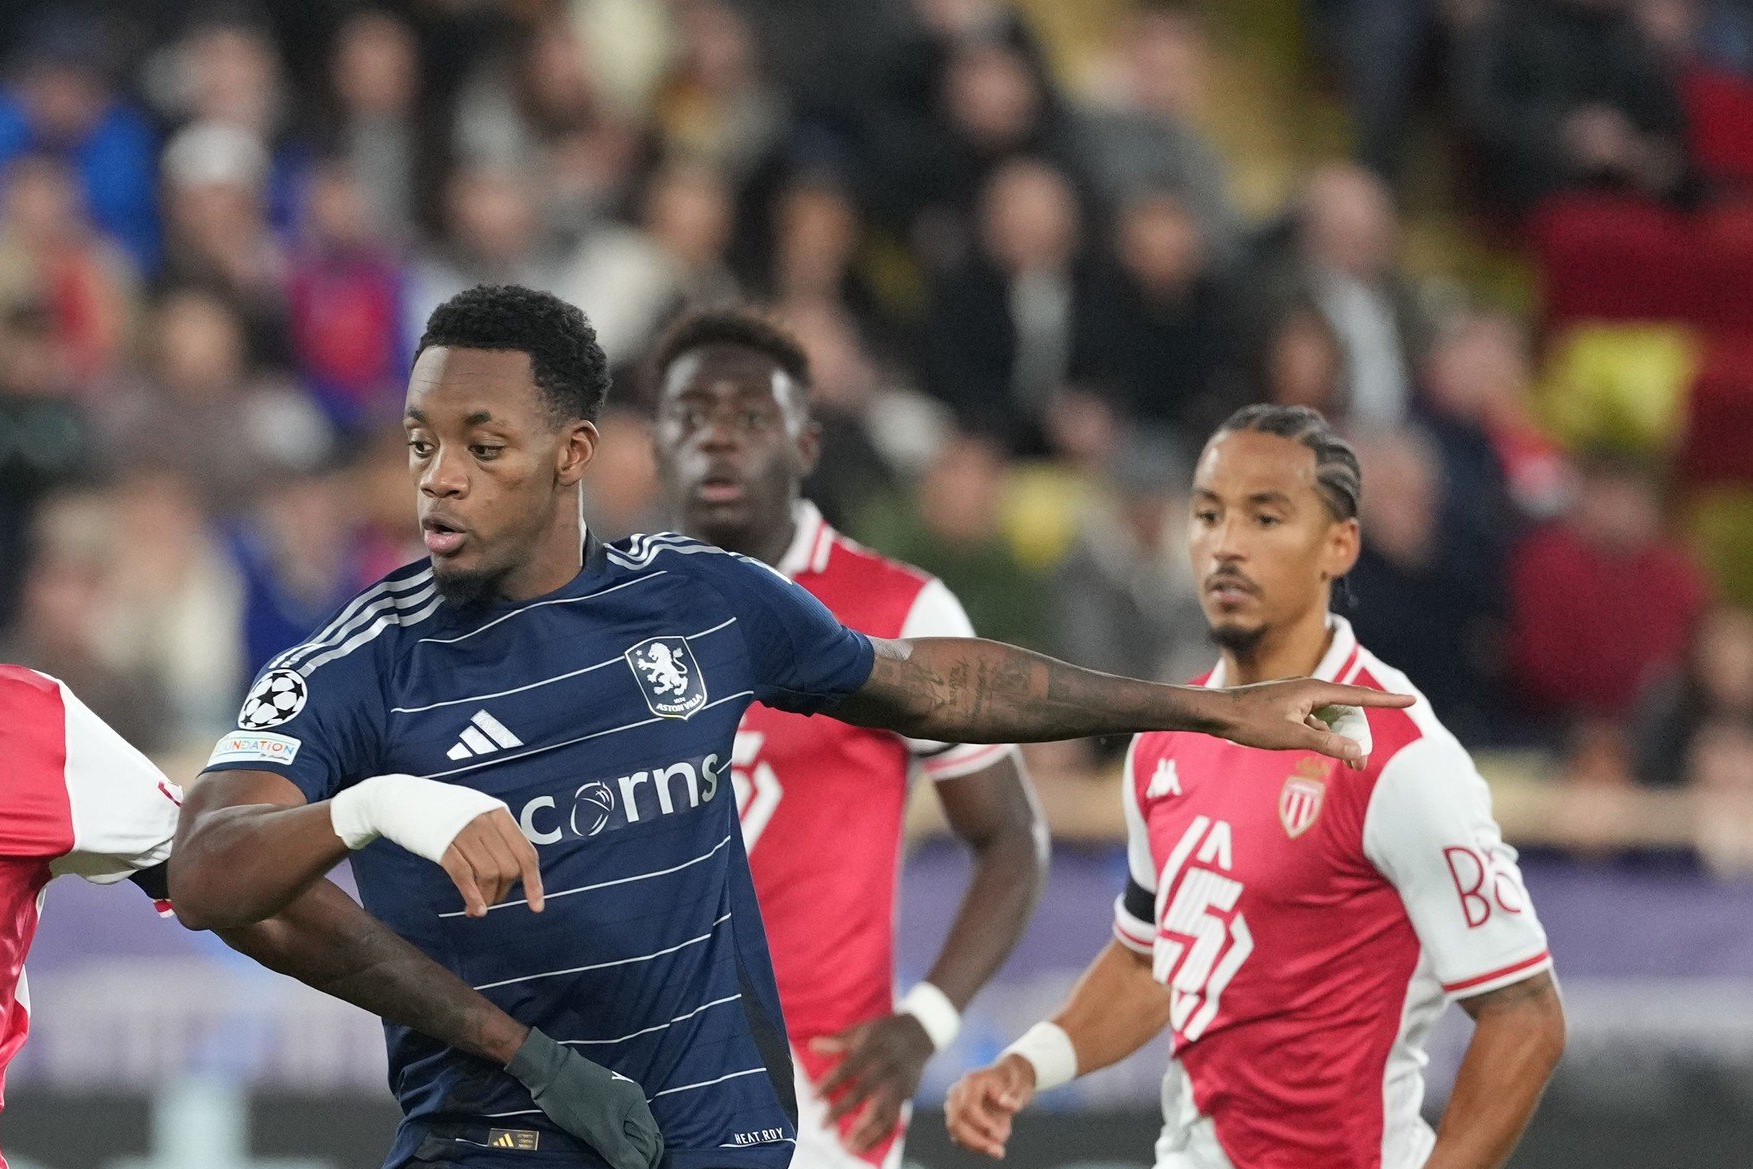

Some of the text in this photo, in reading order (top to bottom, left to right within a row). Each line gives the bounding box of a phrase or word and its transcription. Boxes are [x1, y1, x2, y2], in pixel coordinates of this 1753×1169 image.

[656, 693, 703, 712] ASTON VILLA
[519, 753, 718, 845] corns
[734, 1127, 783, 1145] HEAT.RDY
